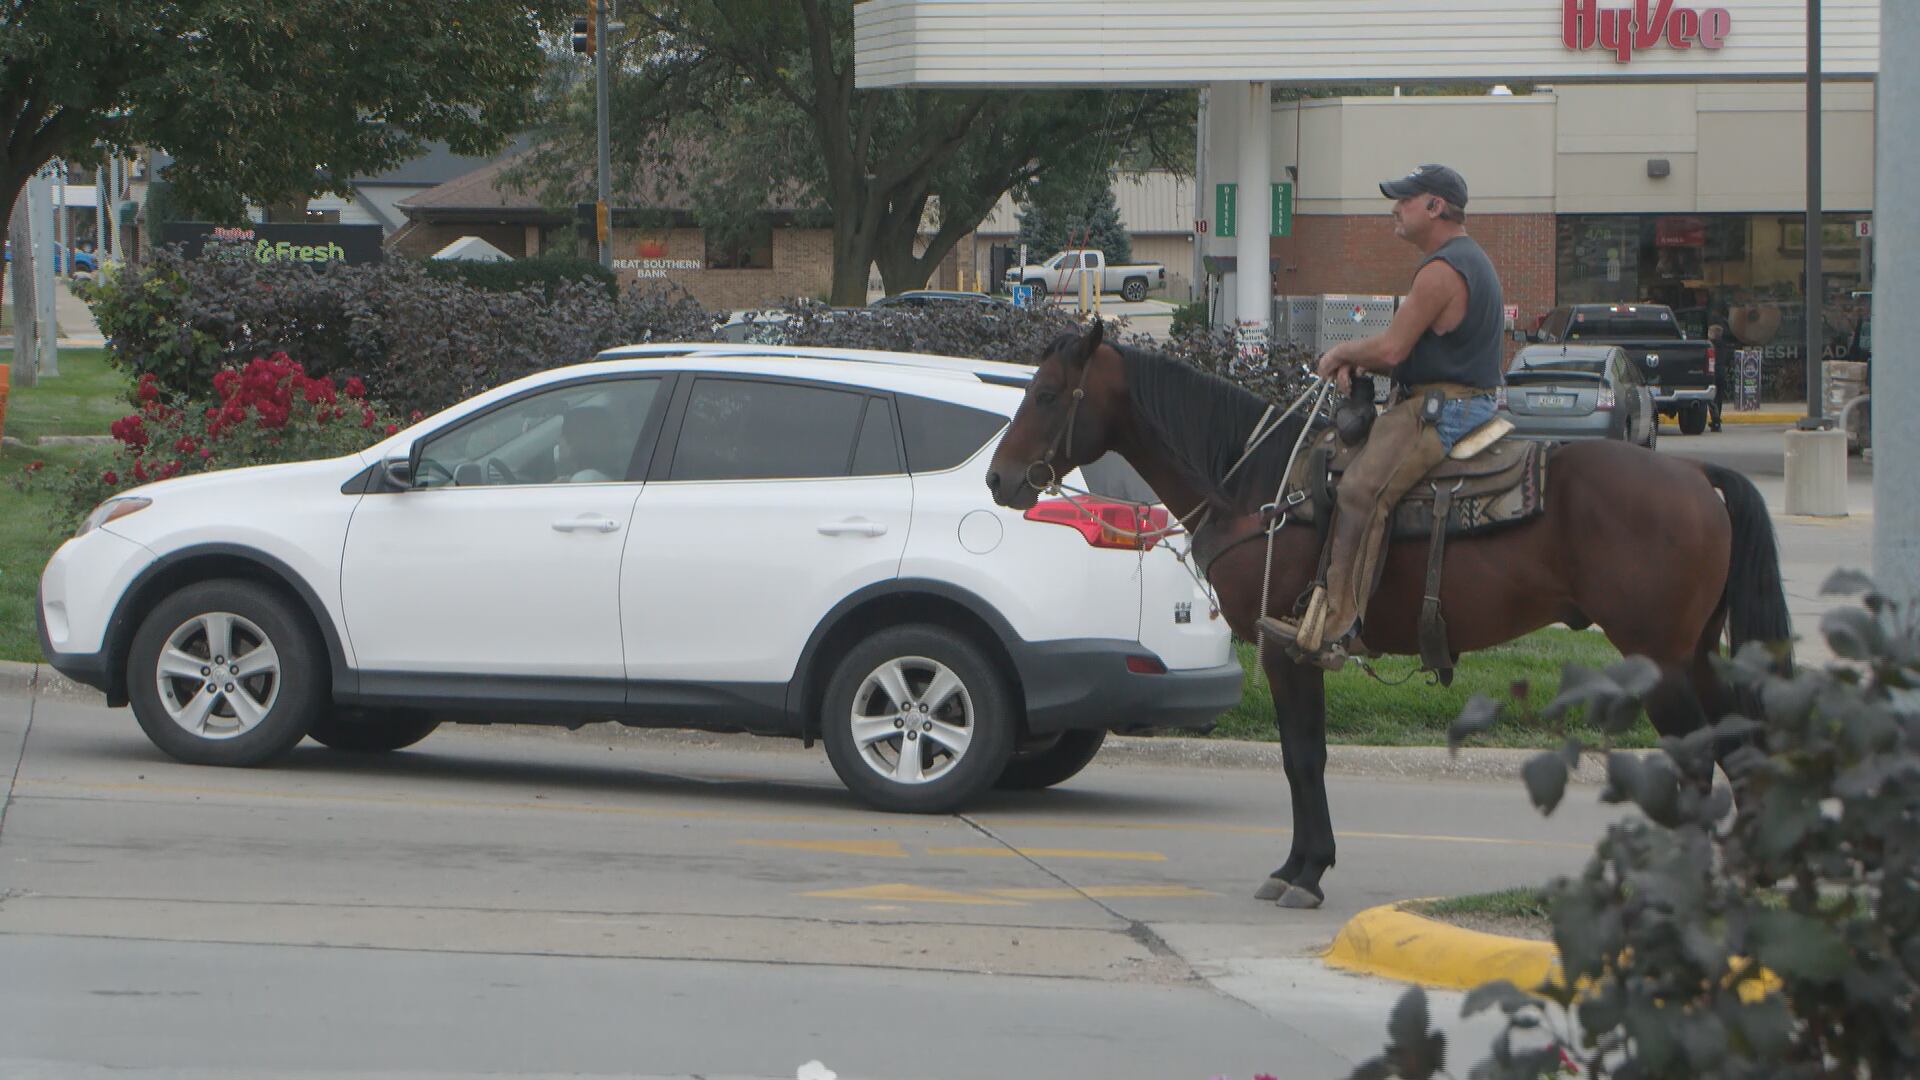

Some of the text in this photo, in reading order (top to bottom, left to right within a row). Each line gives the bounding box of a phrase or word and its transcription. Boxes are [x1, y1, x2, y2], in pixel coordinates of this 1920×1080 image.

[1195, 220, 1207, 233] 10
[1860, 222, 1868, 235] 8
[612, 259, 701, 270] REAT SOUTHERN
[637, 269, 667, 279] BANK
